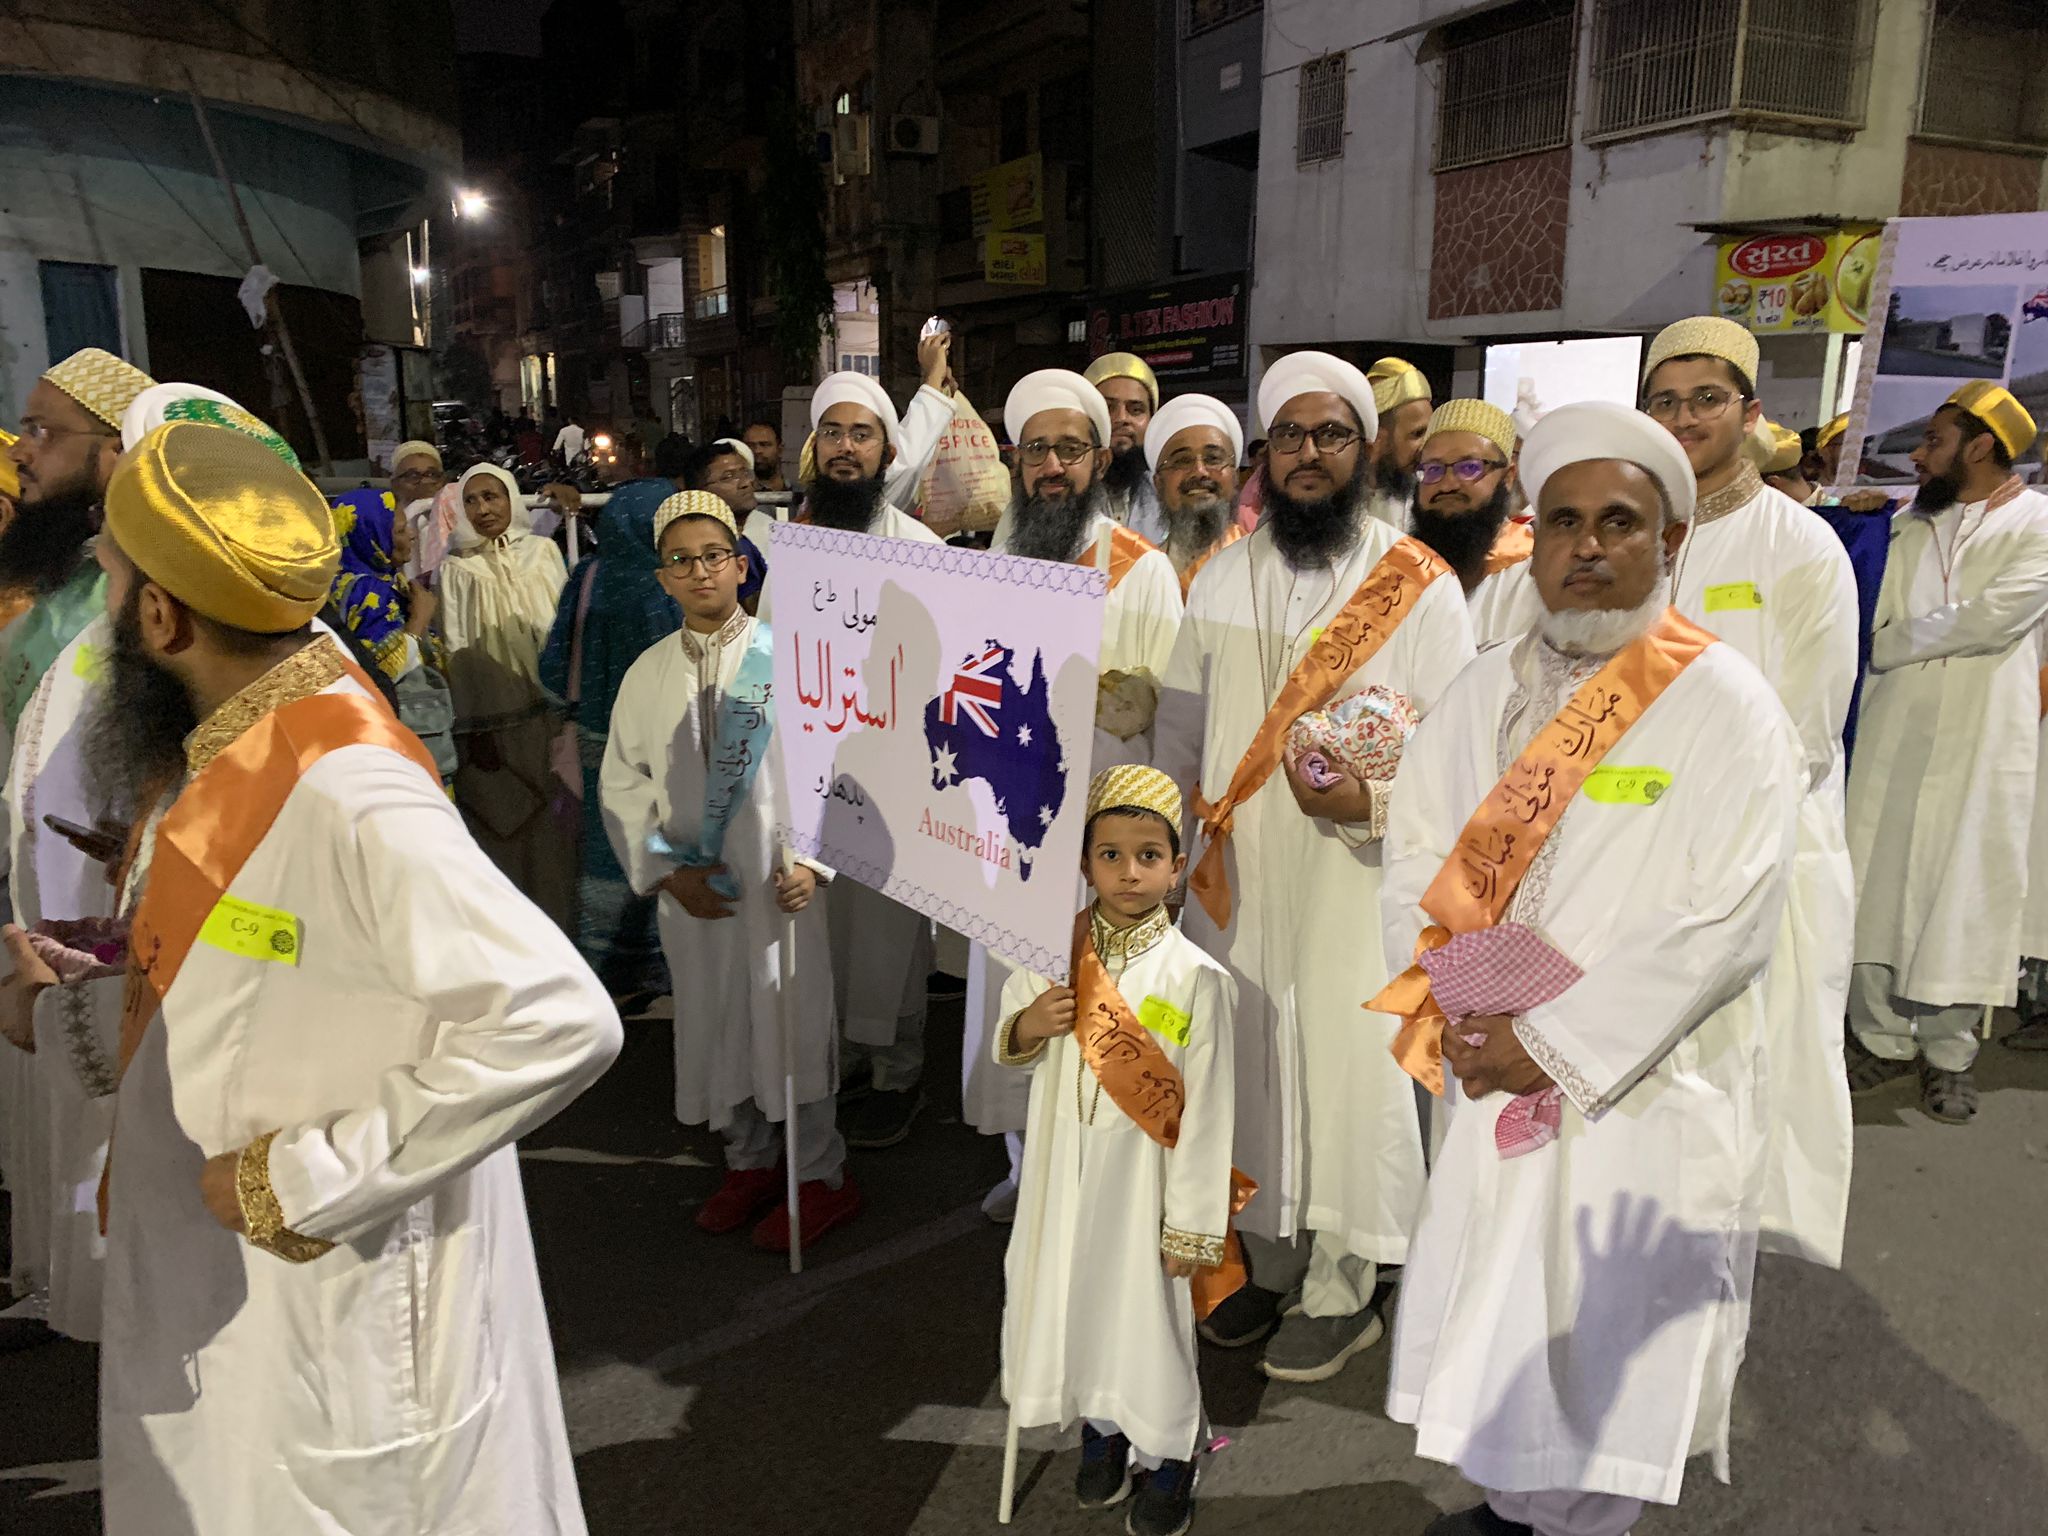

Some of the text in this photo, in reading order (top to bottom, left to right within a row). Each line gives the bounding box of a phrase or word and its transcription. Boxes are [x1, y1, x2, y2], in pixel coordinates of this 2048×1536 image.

[1162, 296, 1236, 334] FASHION
[938, 435, 991, 450] SPICE
[918, 807, 1012, 870] Australia
[230, 917, 260, 937] C-9
